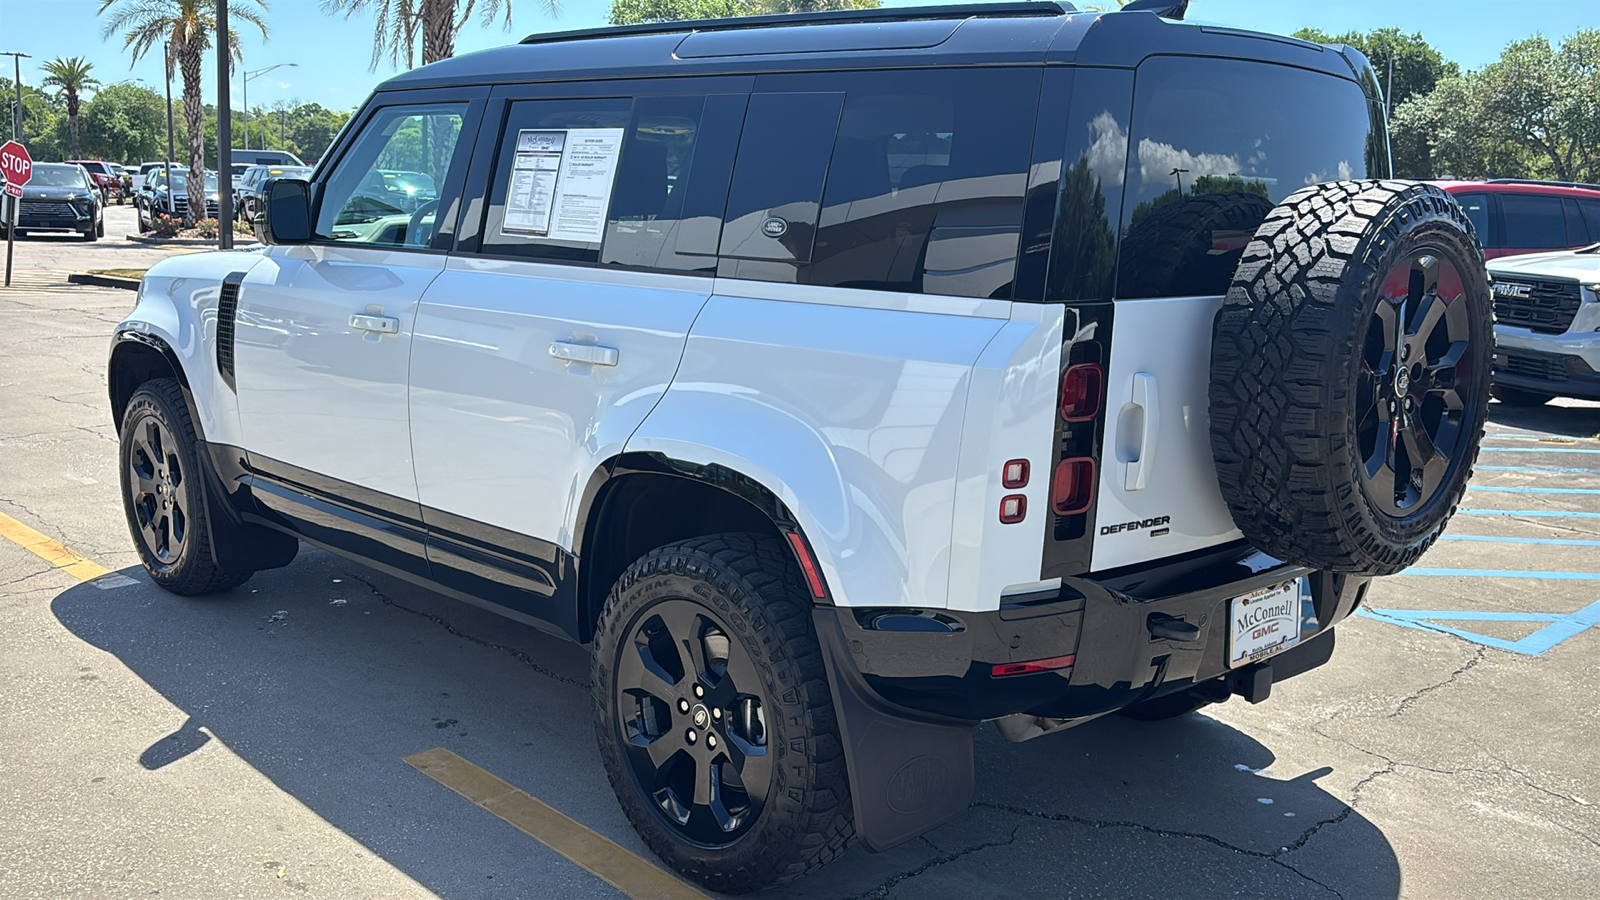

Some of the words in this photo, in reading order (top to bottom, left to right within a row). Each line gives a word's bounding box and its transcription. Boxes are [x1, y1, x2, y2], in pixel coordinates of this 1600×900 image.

[1, 152, 30, 175] STOP
[7, 185, 21, 196] 3-WAY
[1492, 284, 1531, 298] GMC
[1100, 515, 1170, 535] DEFENDER
[1237, 600, 1292, 634] McConnell
[1252, 622, 1279, 640] GMC
